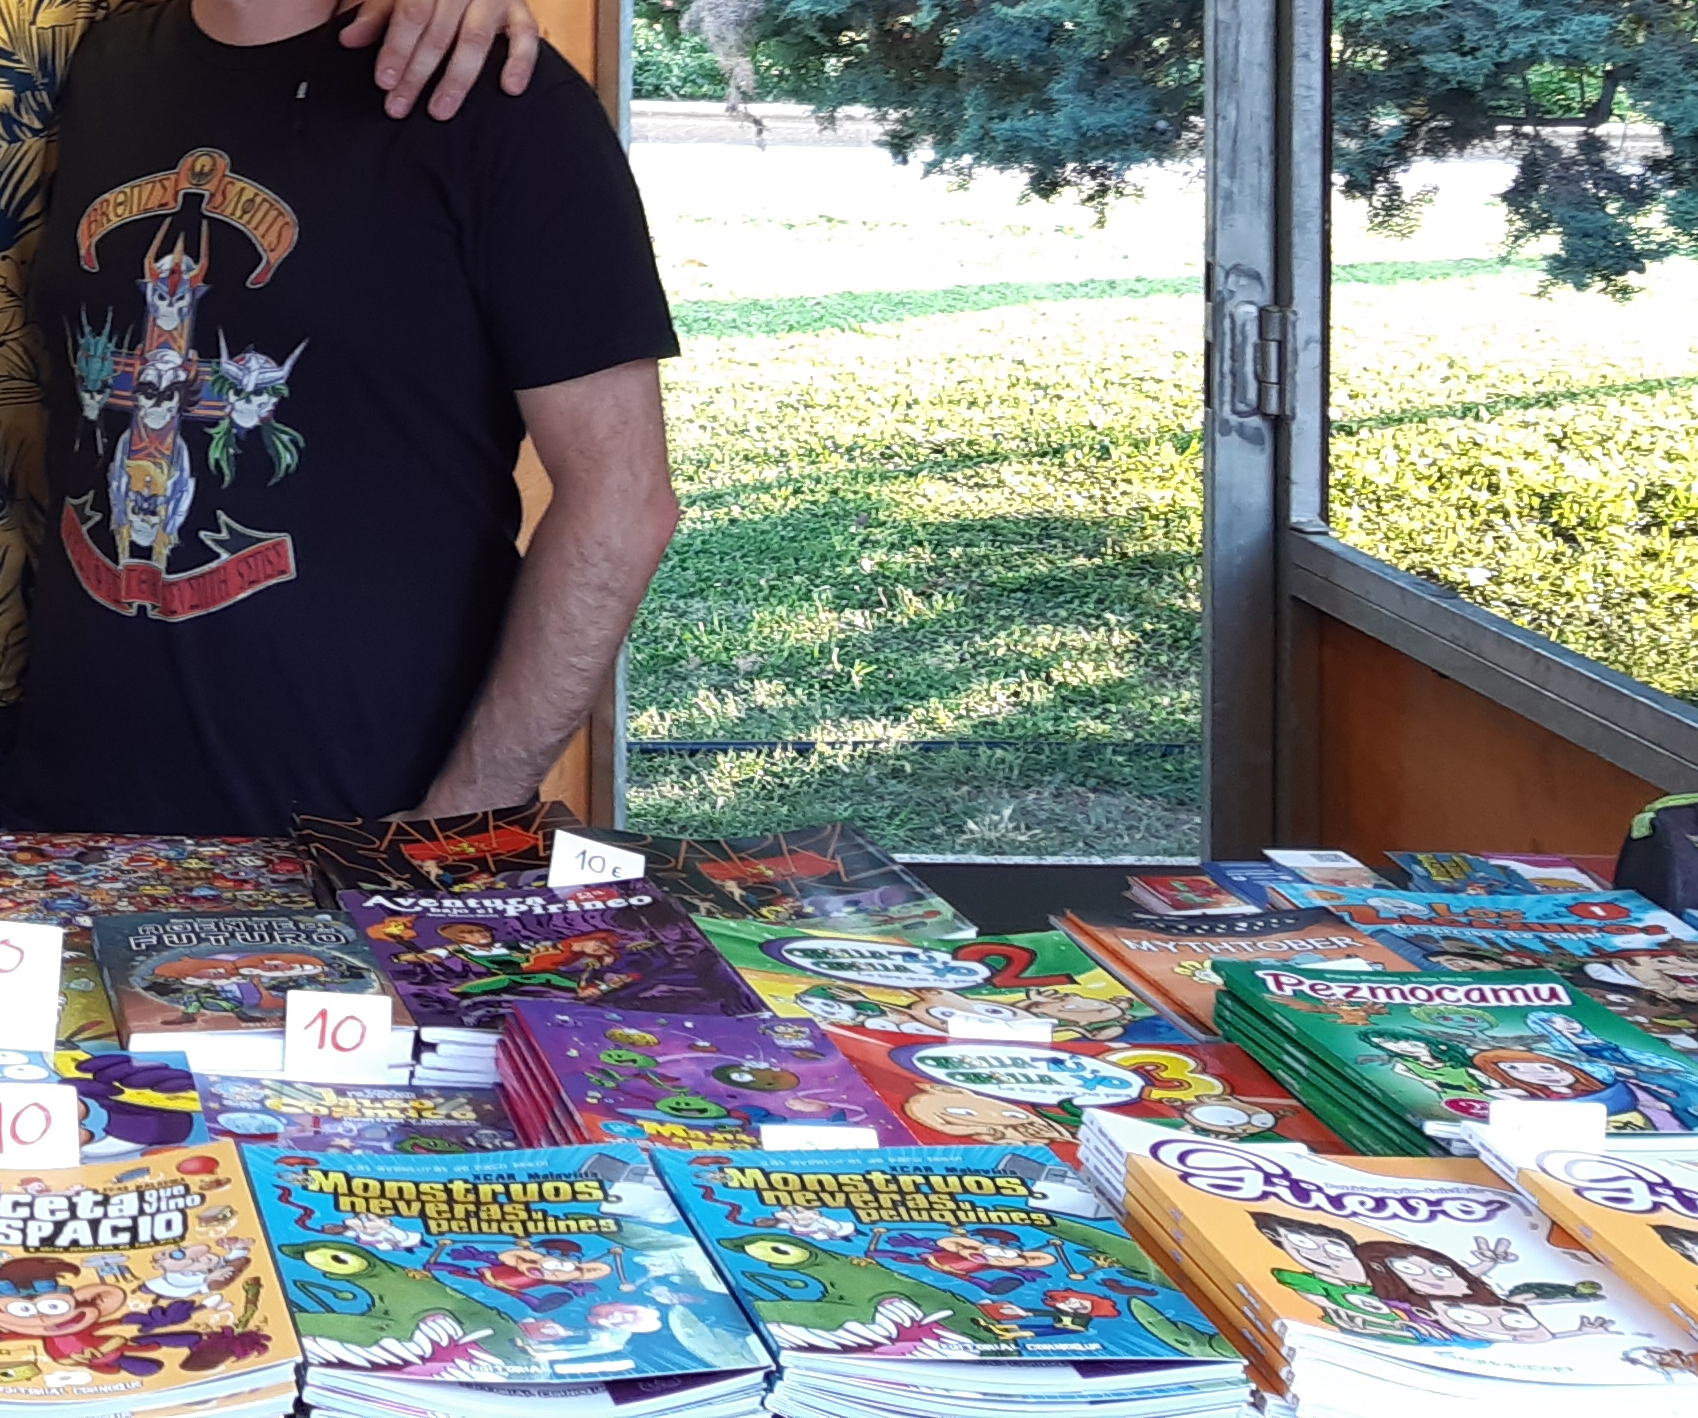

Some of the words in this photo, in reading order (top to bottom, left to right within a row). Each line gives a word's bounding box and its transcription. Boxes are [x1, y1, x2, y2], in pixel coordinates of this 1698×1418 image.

[575, 849, 605, 873] 10
[363, 895, 547, 912] Aventura
[503, 894, 652, 916] Pirineo
[129, 930, 347, 950] FUTURO
[1122, 936, 1364, 954] MYTHTOBER
[954, 942, 1079, 988] 2
[1259, 972, 1569, 1005] Pezmocamu
[304, 1008, 366, 1052] 10
[1103, 1048, 1226, 1102] 3
[338, 1193, 529, 1222] neveras
[761, 1188, 957, 1211] neveras
[427, 1217, 619, 1239] peluquines
[862, 1207, 1053, 1227] peluquines
